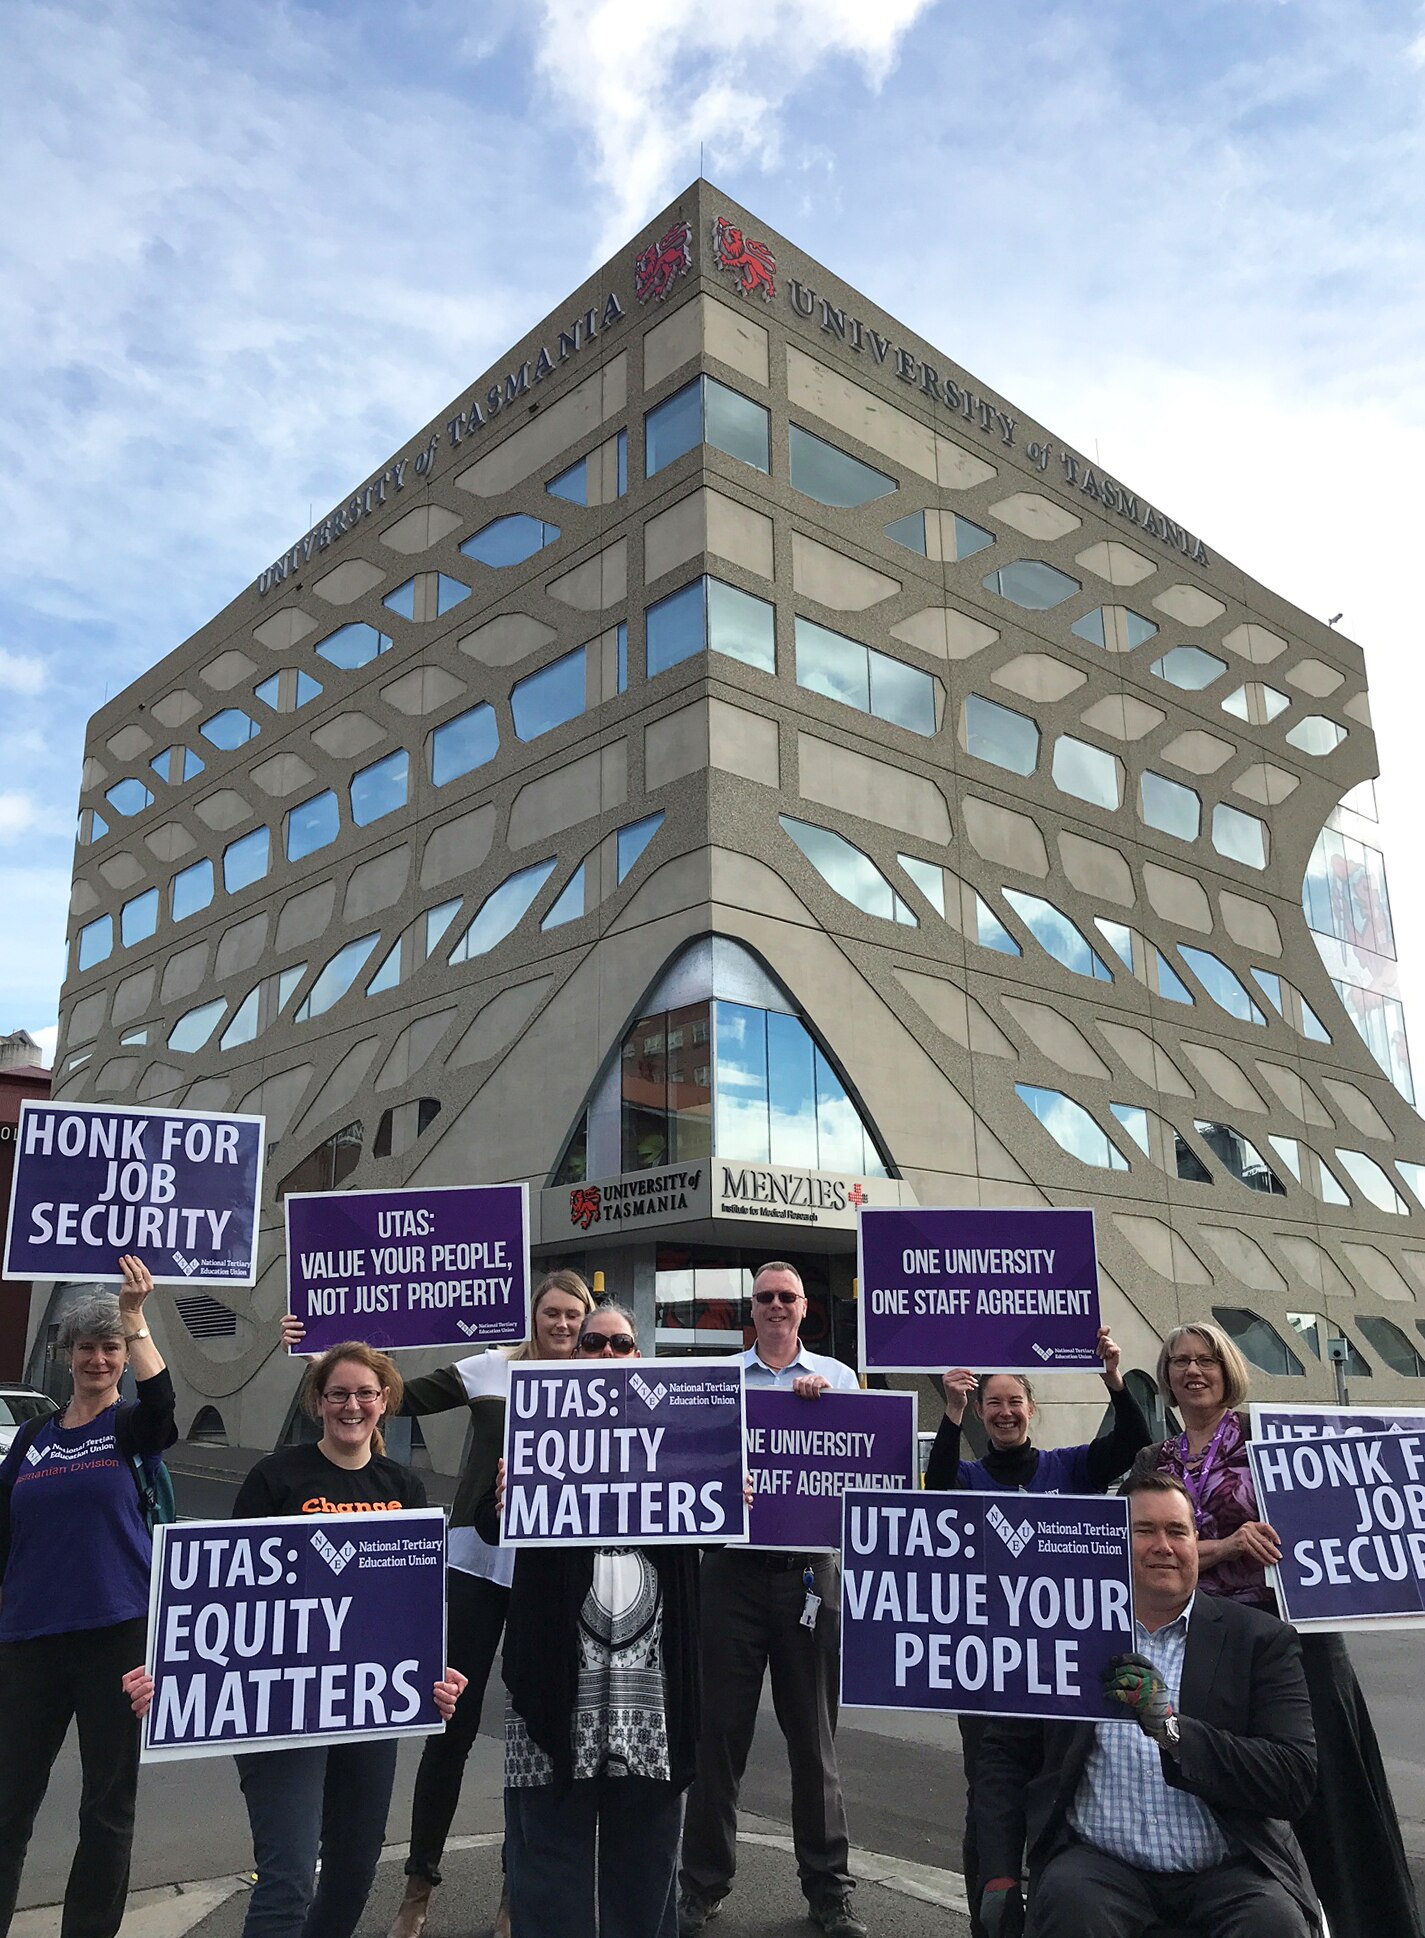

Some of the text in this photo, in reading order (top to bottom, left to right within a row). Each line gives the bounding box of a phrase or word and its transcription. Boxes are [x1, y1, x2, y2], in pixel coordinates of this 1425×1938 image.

[788, 278, 1210, 568] UNIVERSITY of TASMANIA
[256, 292, 625, 596] UNIVERSITY of TASMANIA
[24, 1113, 240, 1164] HONK FOR
[98, 1160, 177, 1204] JOB
[603, 1169, 702, 1201] UNIVERSITY of
[721, 1166, 848, 1211] MENZIES
[28, 1202, 233, 1250] SECURITY
[378, 1209, 435, 1239] UTAS:
[603, 1192, 688, 1221] TASMANIA
[749, 1206, 759, 1215] for
[760, 1207, 786, 1218] Medical
[200, 1259, 252, 1269] National Tertiary
[200, 1267, 247, 1276] Education Union
[300, 1241, 513, 1280] VALUE YOUR PEOPLE,
[902, 1249, 1056, 1274] ONE UNIVERSITY
[307, 1277, 513, 1317] NOT JUST PROPERTY
[871, 1289, 1092, 1316] ONE STAFF AGREEMENT
[514, 1378, 620, 1419] UTAS:
[669, 1382, 740, 1394] National Tertiary
[669, 1395, 736, 1406] Education Union
[90, 1443, 114, 1453] Union
[512, 1427, 666, 1481] EQUITY
[746, 1428, 876, 1458] NE UNIVERSITY
[70, 1458, 119, 1472] Division
[750, 1468, 793, 1495] TAFF
[1258, 1440, 1394, 1492] HONK
[507, 1480, 726, 1536] MATTERS
[1356, 1484, 1425, 1533] JOB
[359, 1538, 443, 1552] National Tertiary
[851, 1506, 976, 1559] UTAS:
[1037, 1521, 1128, 1540] National Tertiary
[1037, 1540, 1122, 1555] Education Union
[169, 1536, 299, 1591] UTAS:
[359, 1553, 437, 1568] Education Union
[843, 1569, 1132, 1632] VALUE YOUR
[163, 1596, 353, 1667] EQUITY
[895, 1632, 1081, 1696] PEOPLE
[153, 1659, 421, 1741] MATTERS
